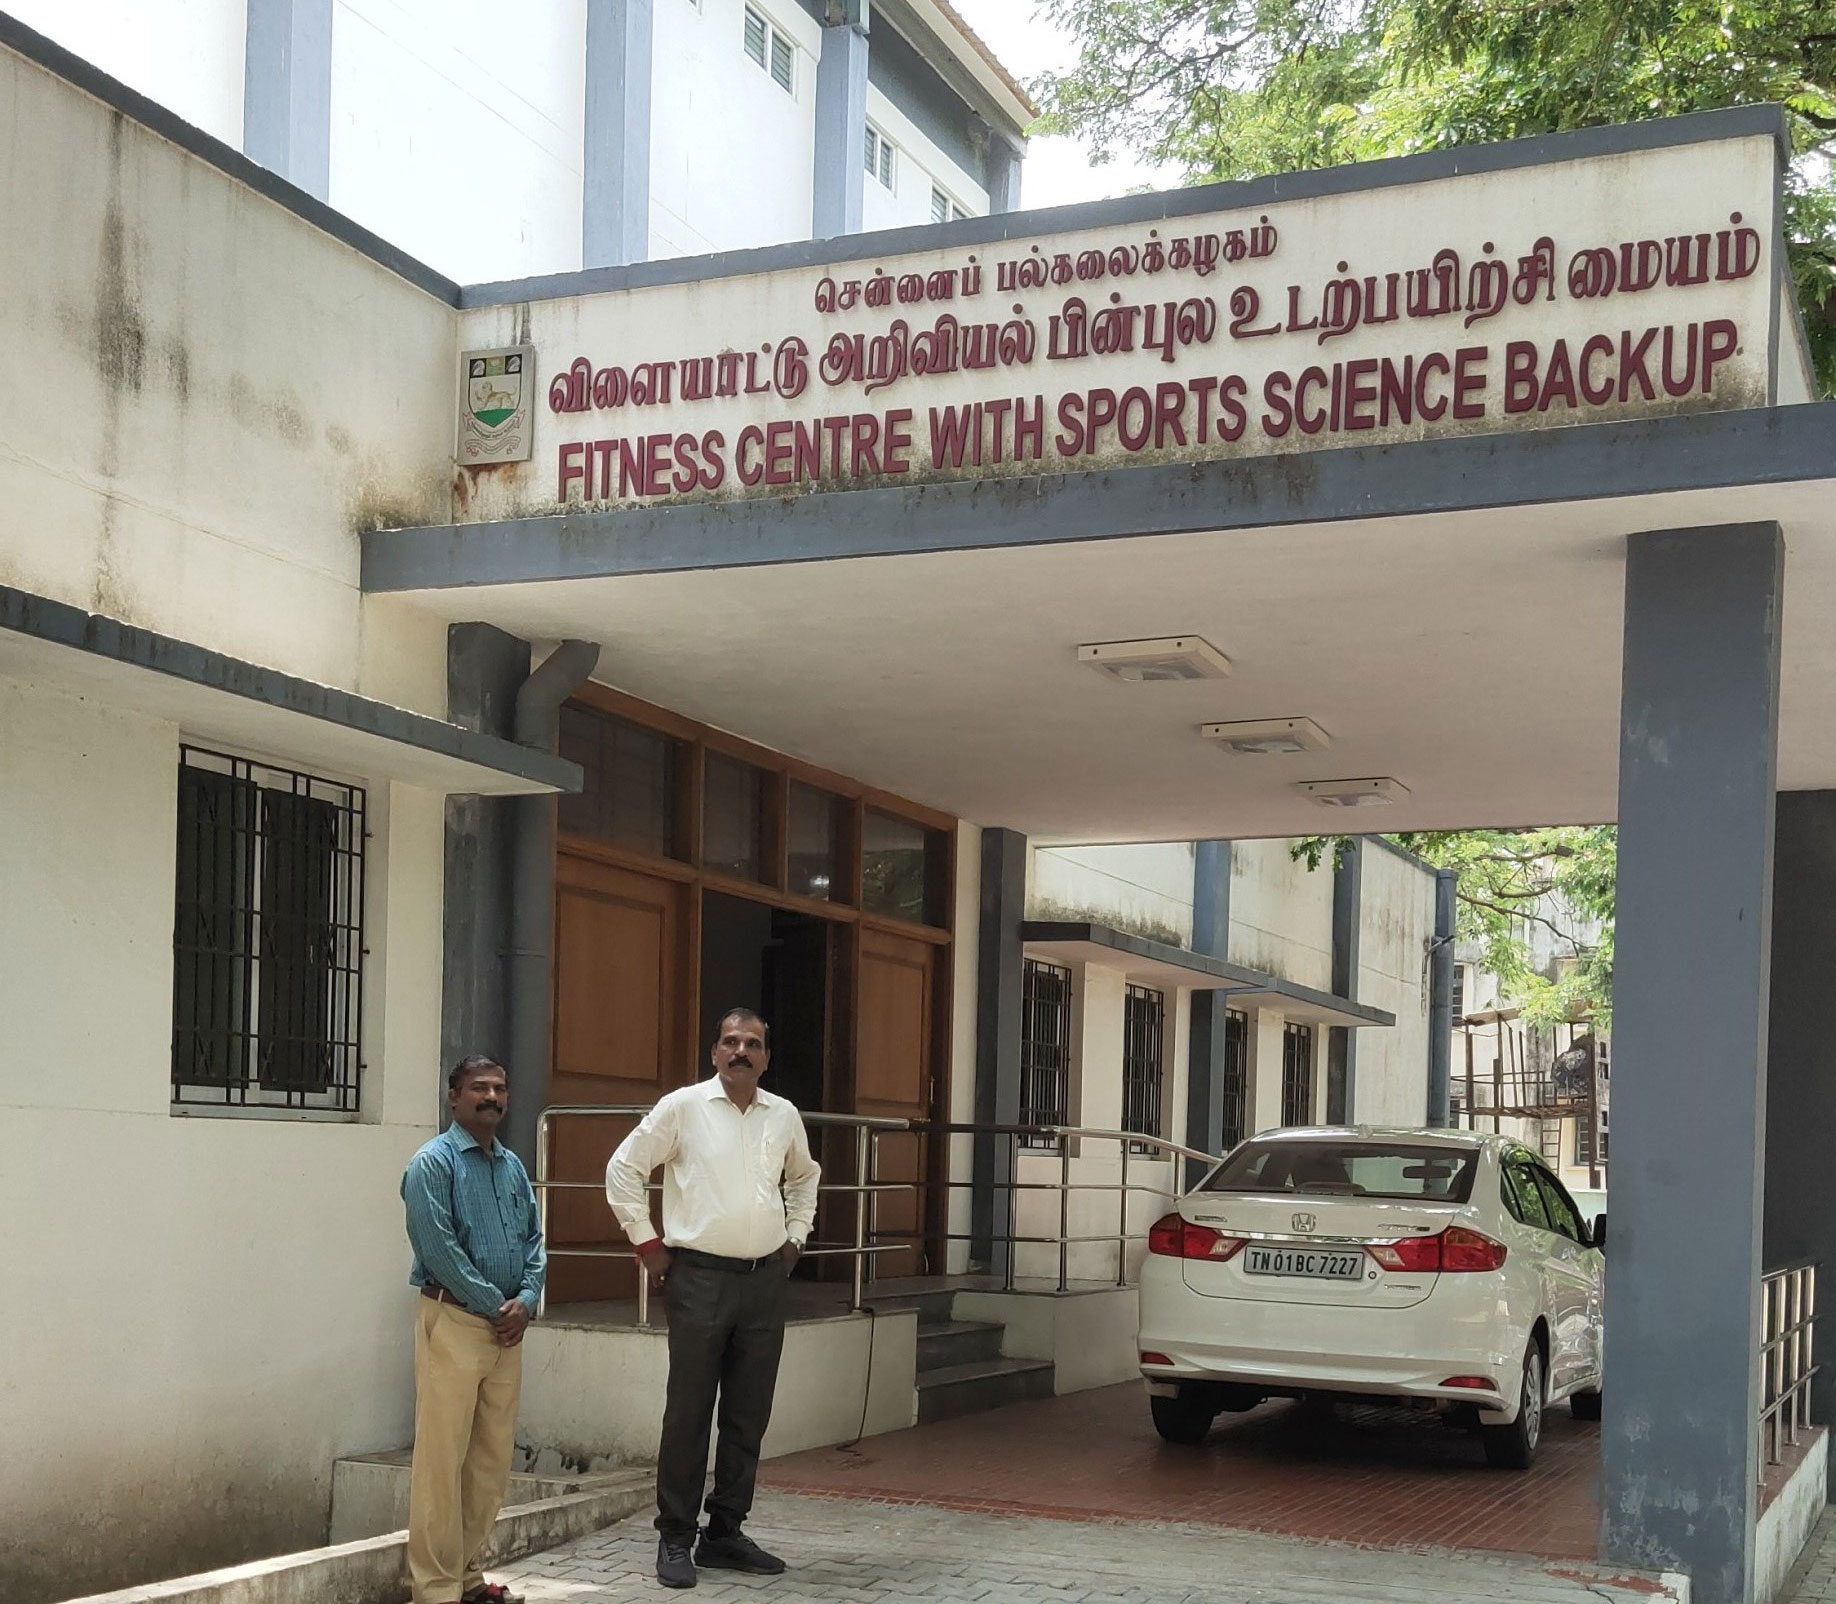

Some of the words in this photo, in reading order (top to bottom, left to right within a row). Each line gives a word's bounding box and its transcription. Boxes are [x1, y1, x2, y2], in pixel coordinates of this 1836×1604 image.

[548, 334, 809, 415] விளையாட்டு
[818, 303, 1036, 396] அறிவியல்
[1046, 291, 1216, 363] பின்புல
[1228, 236, 1556, 346] உடற்பயிற்சி
[1567, 211, 1761, 299] மையம்
[815, 255, 981, 314] சென்னைப்
[995, 215, 1278, 293] பல்கலைக்கழகம்
[558, 429, 726, 503] FITNESS
[735, 408, 913, 486] CENTRE
[928, 394, 1045, 470] WITH
[1054, 374, 1248, 458] SPORTS
[1262, 346, 1488, 438] SCIENCE
[1504, 319, 1738, 414] BACKUP
